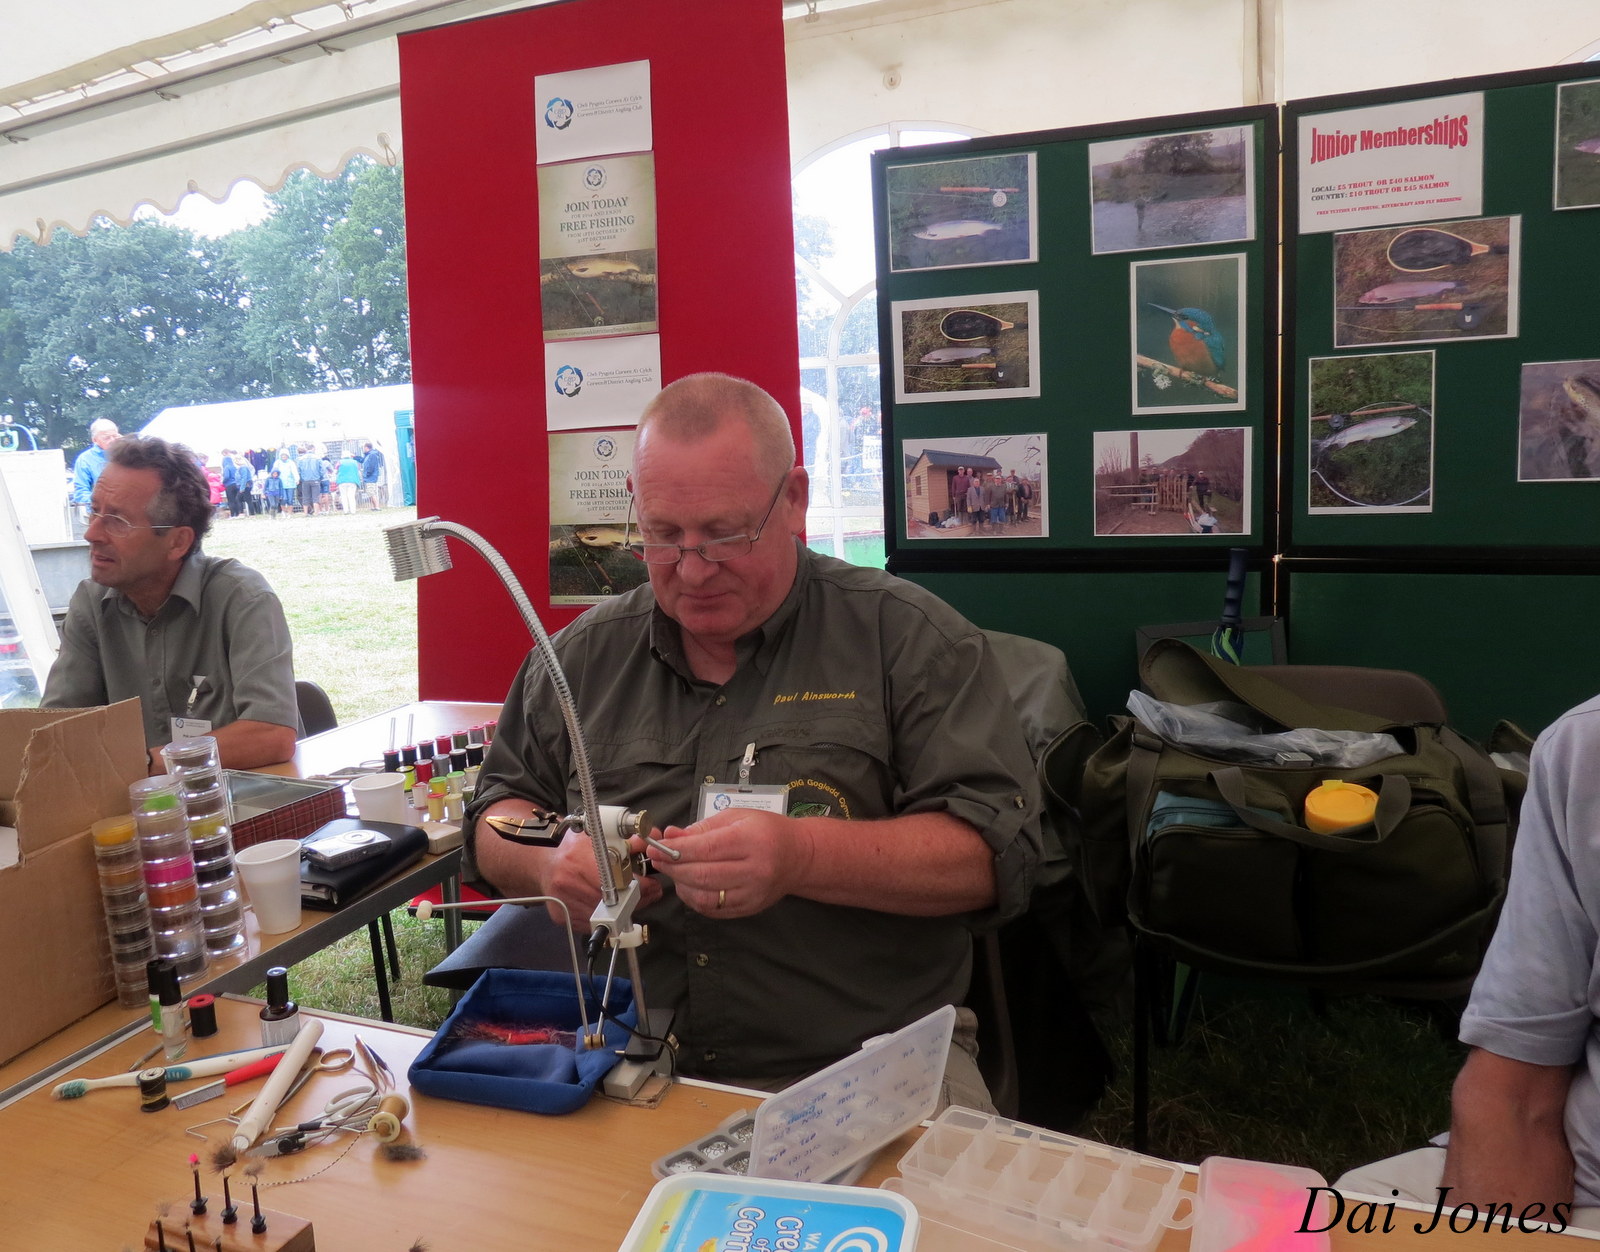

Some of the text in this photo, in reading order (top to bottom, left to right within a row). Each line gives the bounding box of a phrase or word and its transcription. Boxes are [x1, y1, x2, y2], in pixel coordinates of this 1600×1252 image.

[1310, 114, 1469, 165] Junior Memberships
[1311, 185, 1336, 193] LOCAL:
[1348, 181, 1373, 190] TROUT
[1404, 174, 1435, 184] SALMON
[1311, 192, 1348, 201] COUNTRY:
[1364, 188, 1390, 196] TROUT
[1404, 184, 1417, 192] £45
[1418, 181, 1450, 190] SALMON
[565, 197, 628, 213] JOIN TODAY
[560, 215, 635, 232] FREE FISHING
[574, 470, 630, 480] JOIN TODA
[570, 488, 632, 499] FREE FISHI
[773, 690, 856, 705] Paul Ainsworth
[774, 1215, 804, 1252] Cre
